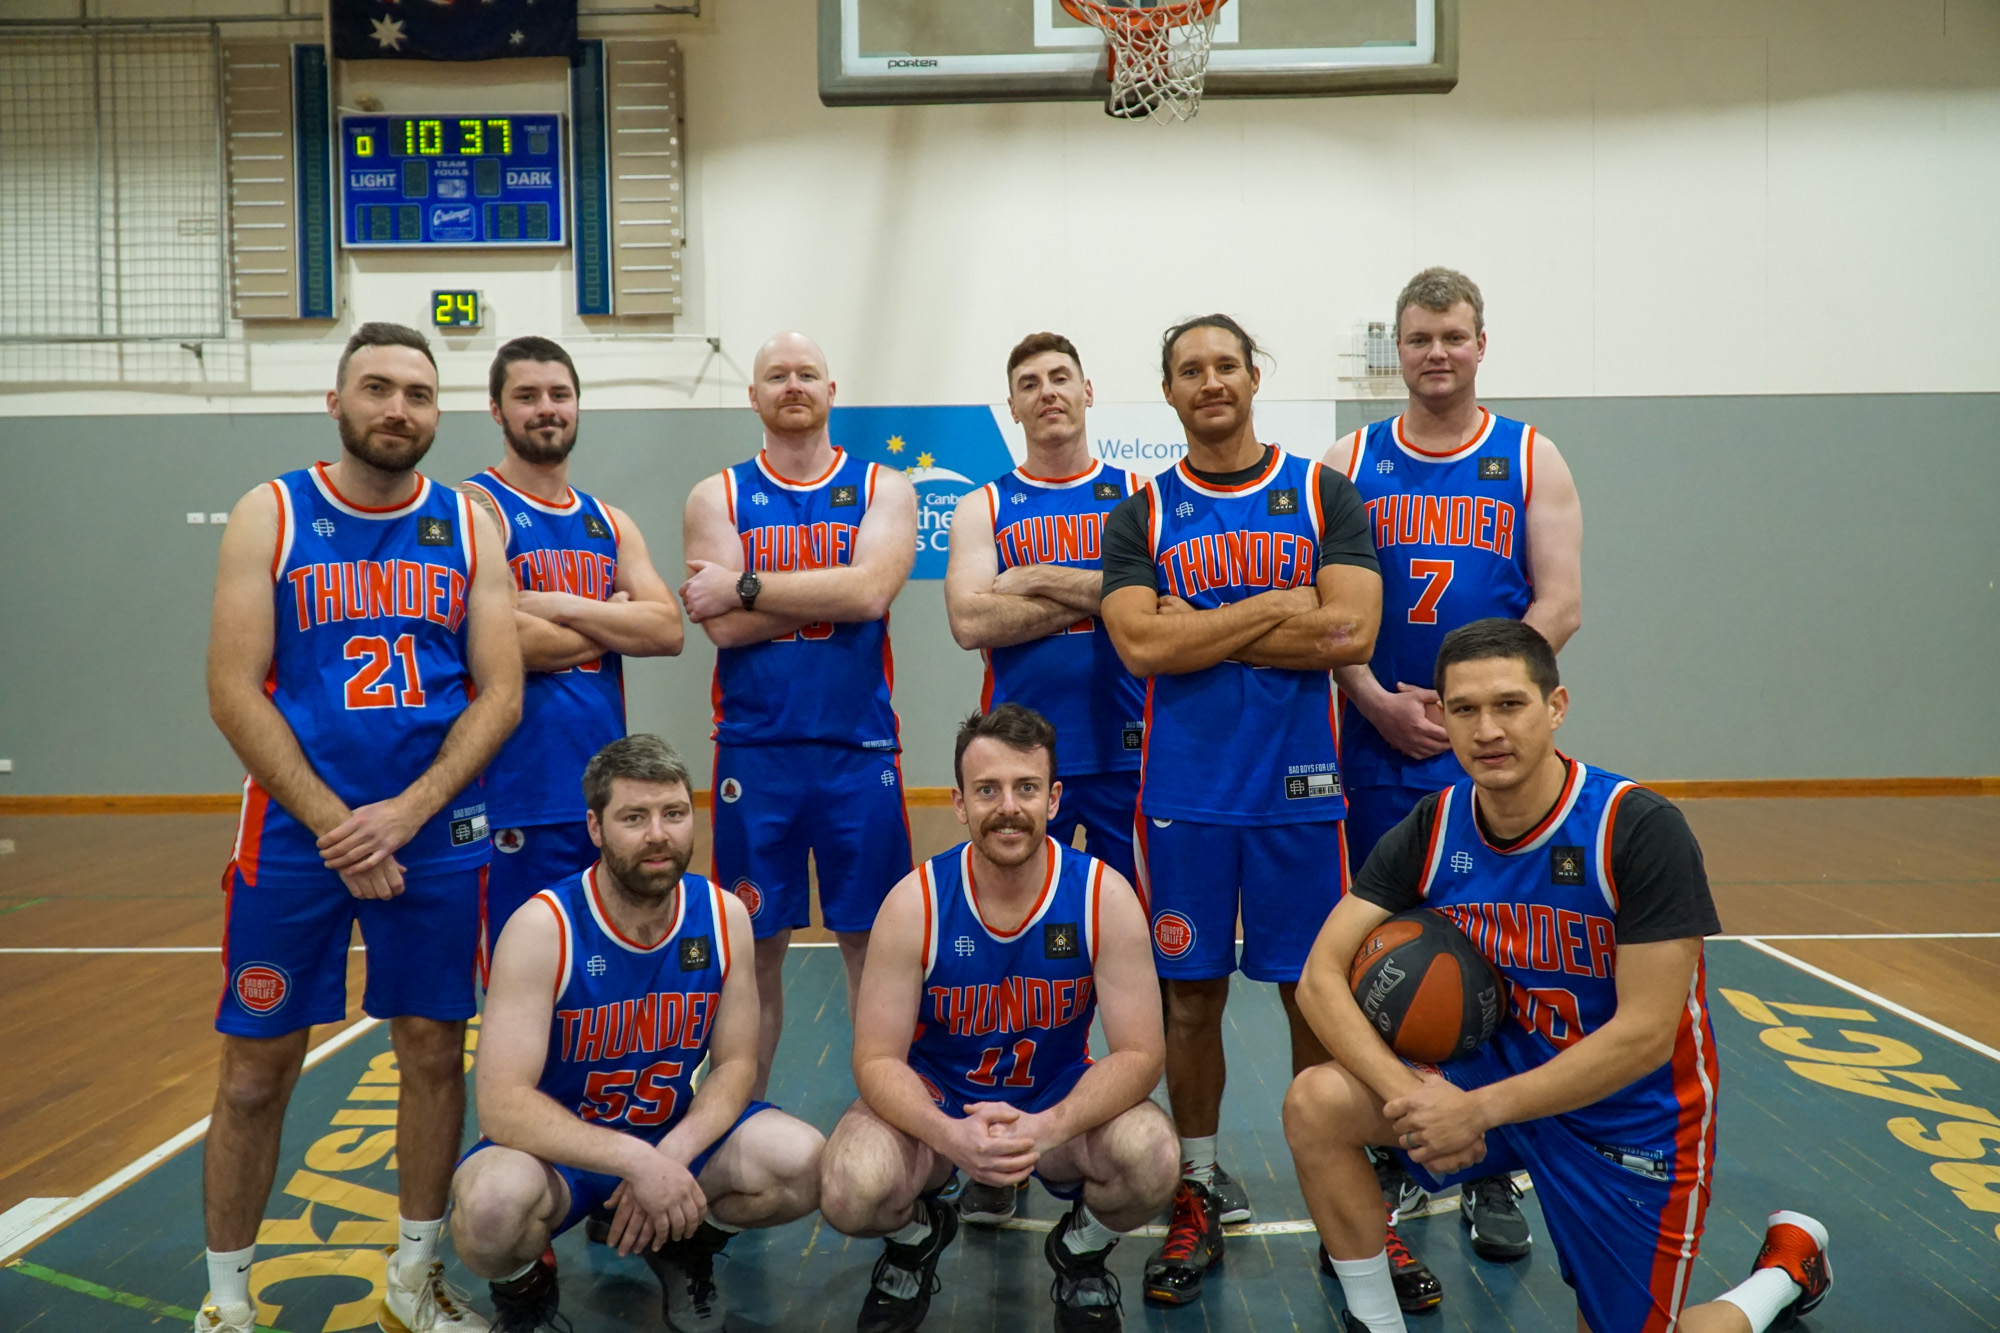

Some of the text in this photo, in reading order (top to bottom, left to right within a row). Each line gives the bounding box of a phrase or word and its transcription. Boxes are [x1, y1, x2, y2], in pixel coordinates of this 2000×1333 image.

[351, 173, 396, 187] LIGHT
[434, 169, 469, 177] FOULS
[506, 171, 551, 185] DARK
[436, 295, 474, 322] 24
[995, 511, 1109, 569] THUND
[1158, 529, 1314, 598] THUNDER
[287, 558, 467, 635] THUNDER
[508, 549, 617, 602] THUNDE
[1408, 558, 1454, 625] 7
[343, 633, 426, 711] 21
[1288, 762, 1336, 775] BAD BOYS FOR LIFE
[1436, 902, 1616, 978] HUNDER
[928, 975, 1093, 1037] THUNDER
[966, 1038, 1036, 1088] 11
[577, 1061, 684, 1126] 55
